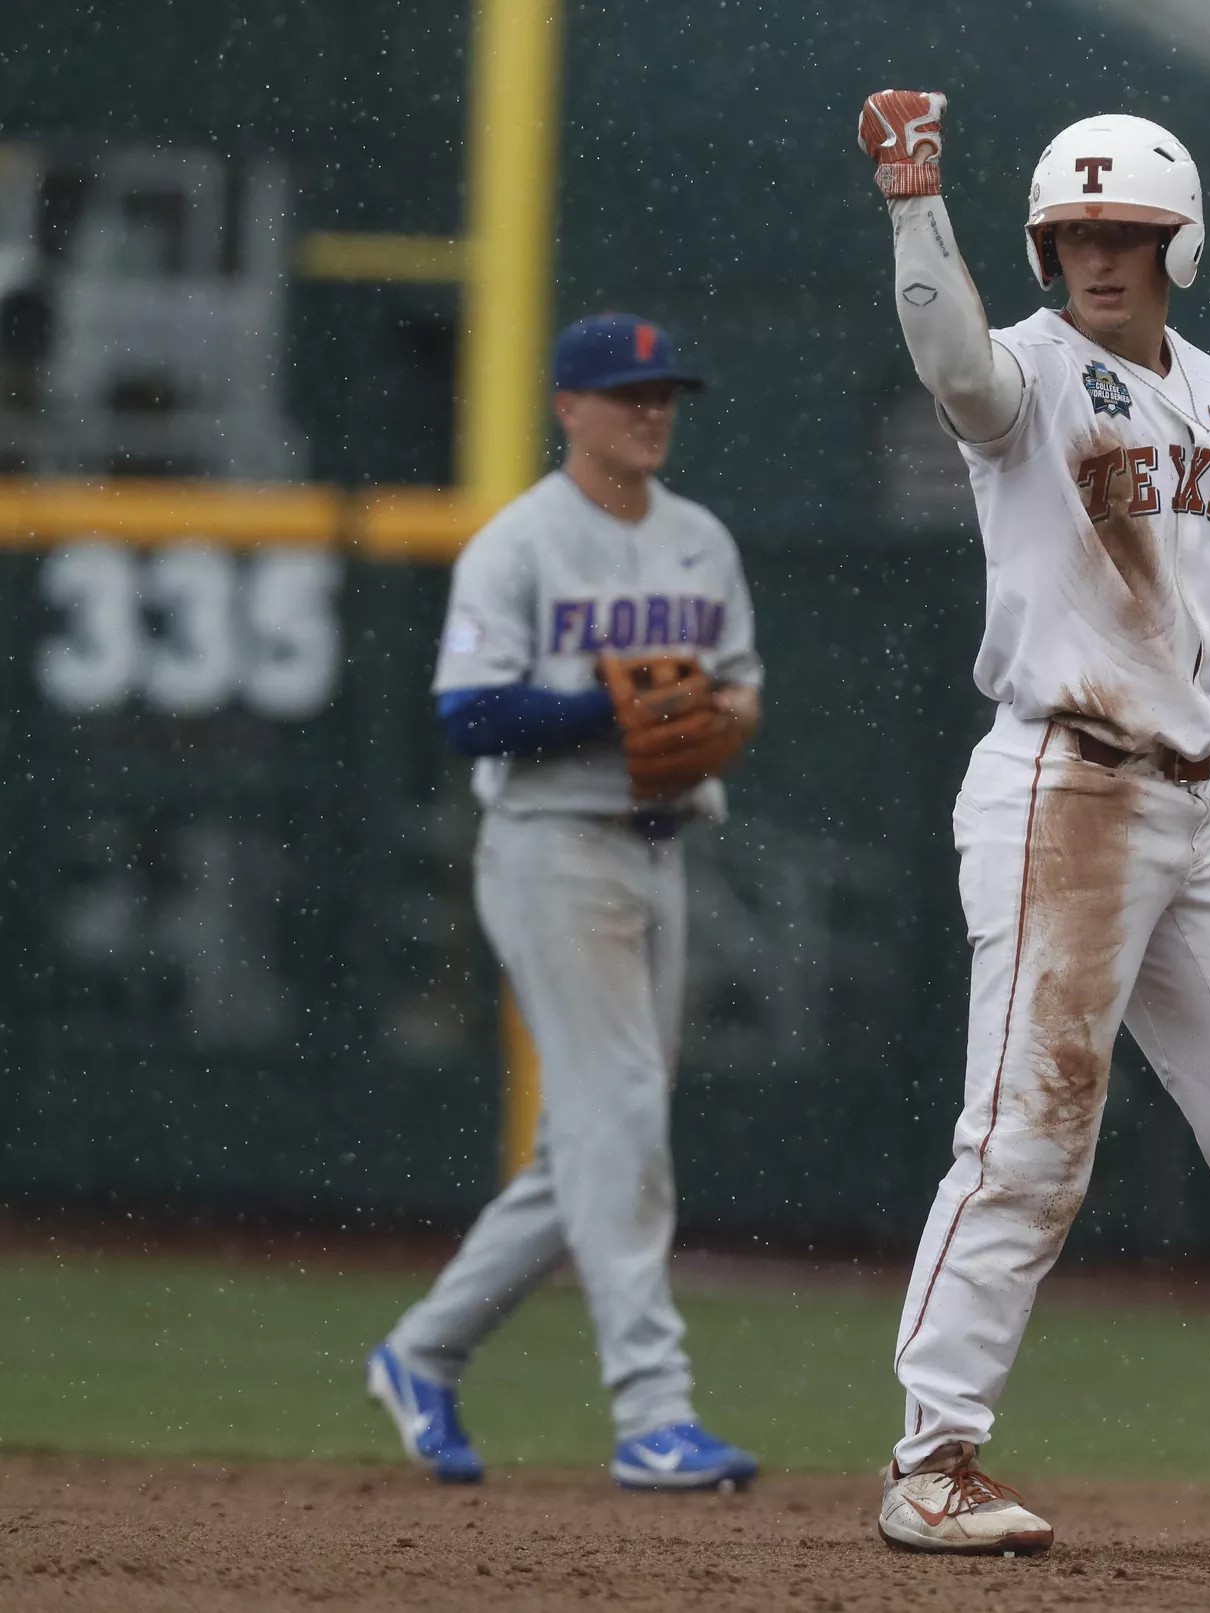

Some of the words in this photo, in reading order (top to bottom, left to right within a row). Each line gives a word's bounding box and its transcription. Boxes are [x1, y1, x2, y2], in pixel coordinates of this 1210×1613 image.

[1075, 157, 1113, 194] T
[1095, 382, 1120, 393] COLLEGE
[38, 545, 346, 716] 335
